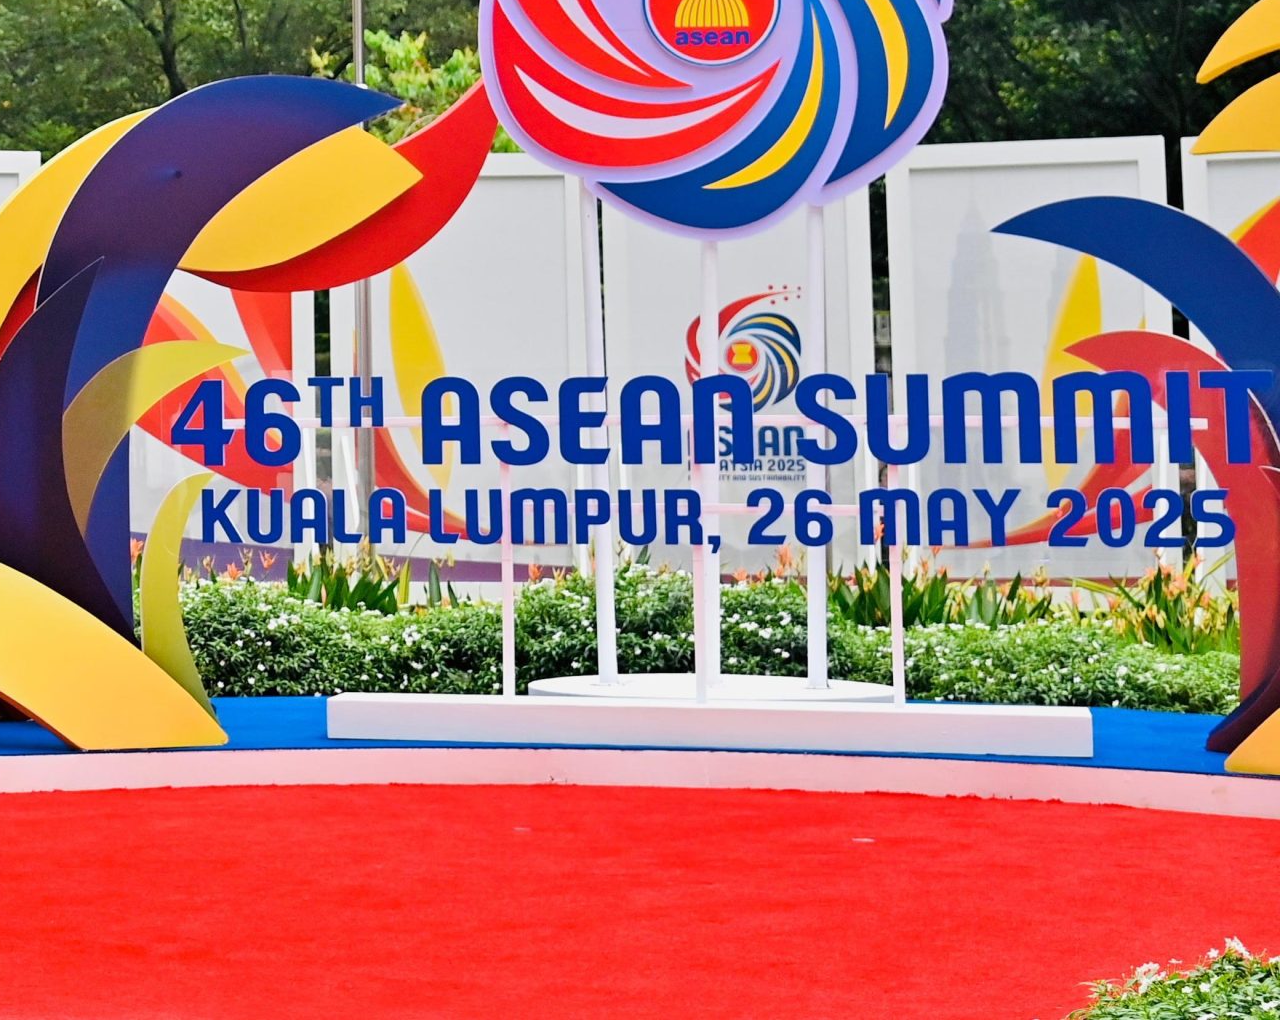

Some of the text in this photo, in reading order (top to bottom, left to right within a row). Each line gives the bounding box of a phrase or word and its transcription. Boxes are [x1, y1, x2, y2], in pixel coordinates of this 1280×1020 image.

[675, 31, 750, 45] asean
[171, 370, 1274, 467] 46TH ASEAN SUMMIT
[767, 459, 806, 472] 2025
[201, 488, 1237, 554] KUALA LUMPUR, 26 MAY 2025
